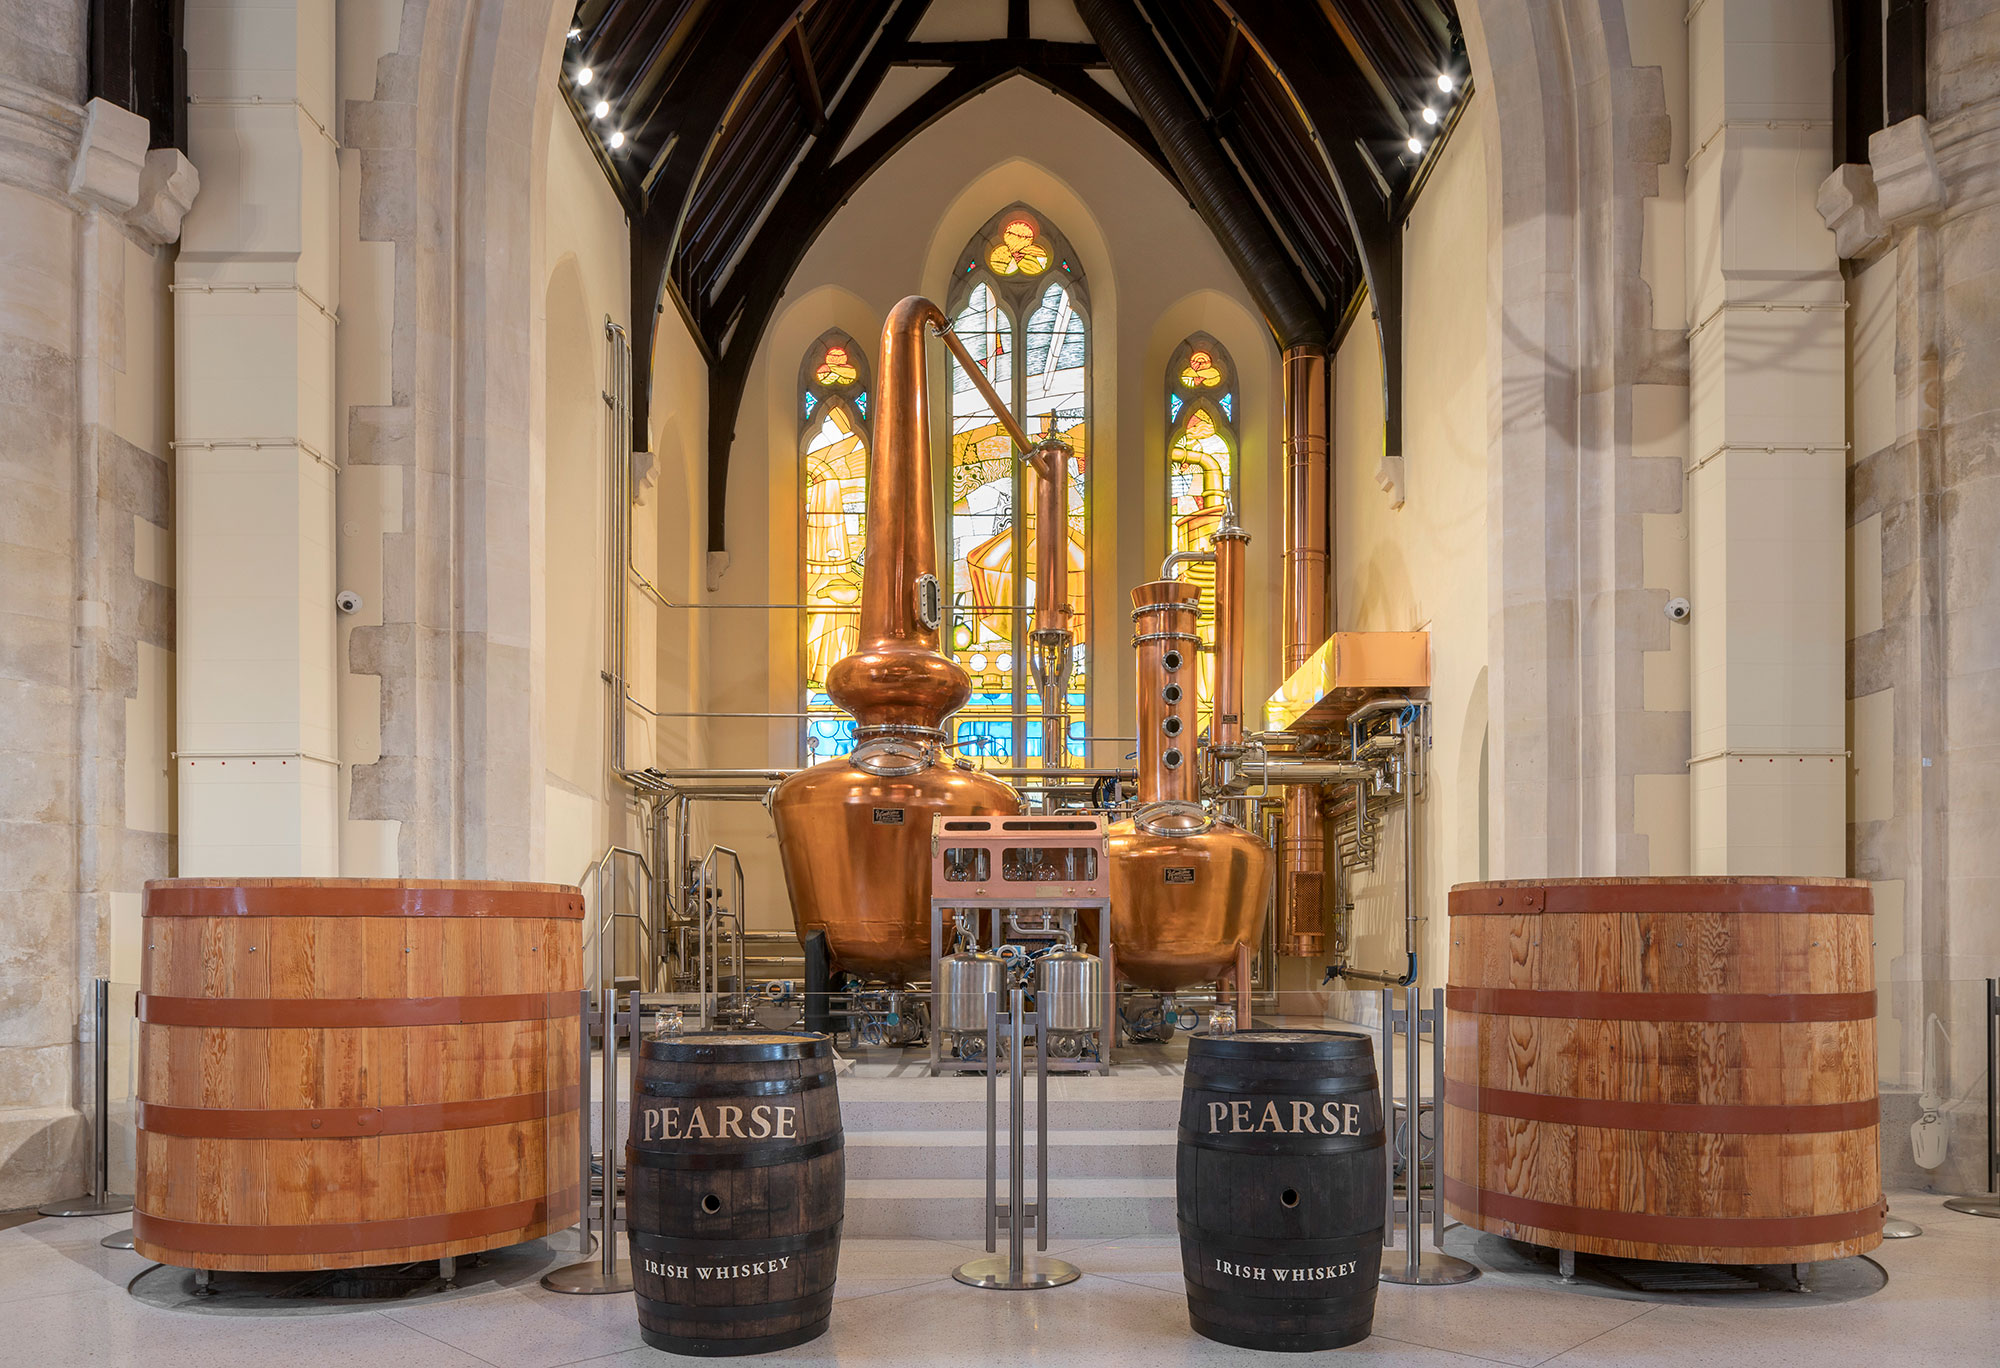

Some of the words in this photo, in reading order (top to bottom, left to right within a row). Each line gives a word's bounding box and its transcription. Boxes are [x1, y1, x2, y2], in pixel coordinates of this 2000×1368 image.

[643, 1105, 797, 1141] PEARSE
[1208, 1100, 1361, 1136] PEARSE
[645, 1259, 688, 1279] IRISH
[696, 1256, 790, 1280] WHISKEY
[1215, 1259, 1266, 1281] IRISH
[1272, 1260, 1357, 1282] WHISKEY
